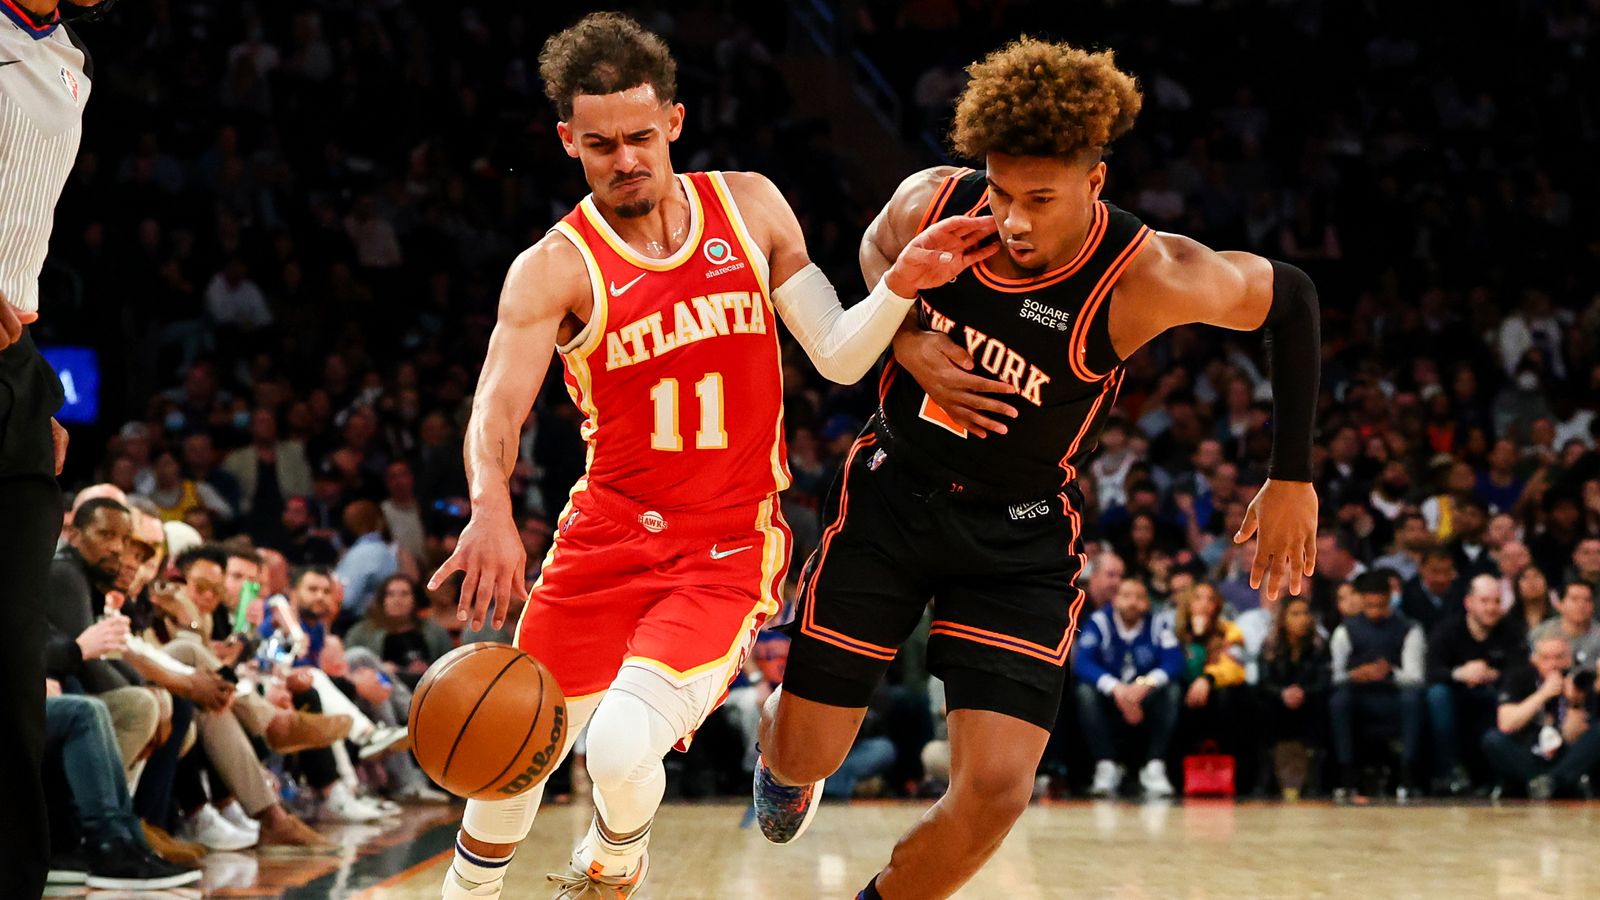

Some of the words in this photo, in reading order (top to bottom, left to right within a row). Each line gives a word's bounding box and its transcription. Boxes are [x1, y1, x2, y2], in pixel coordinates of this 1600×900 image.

[705, 262, 745, 279] sharecare
[605, 291, 767, 371] ATLANTA
[1019, 308, 1057, 329] SPACE
[1022, 298, 1070, 322] SQUARE
[963, 325, 1051, 407] YORK
[650, 372, 728, 452] 11
[637, 513, 669, 530] HAWKS
[496, 705, 564, 794] Wilson
